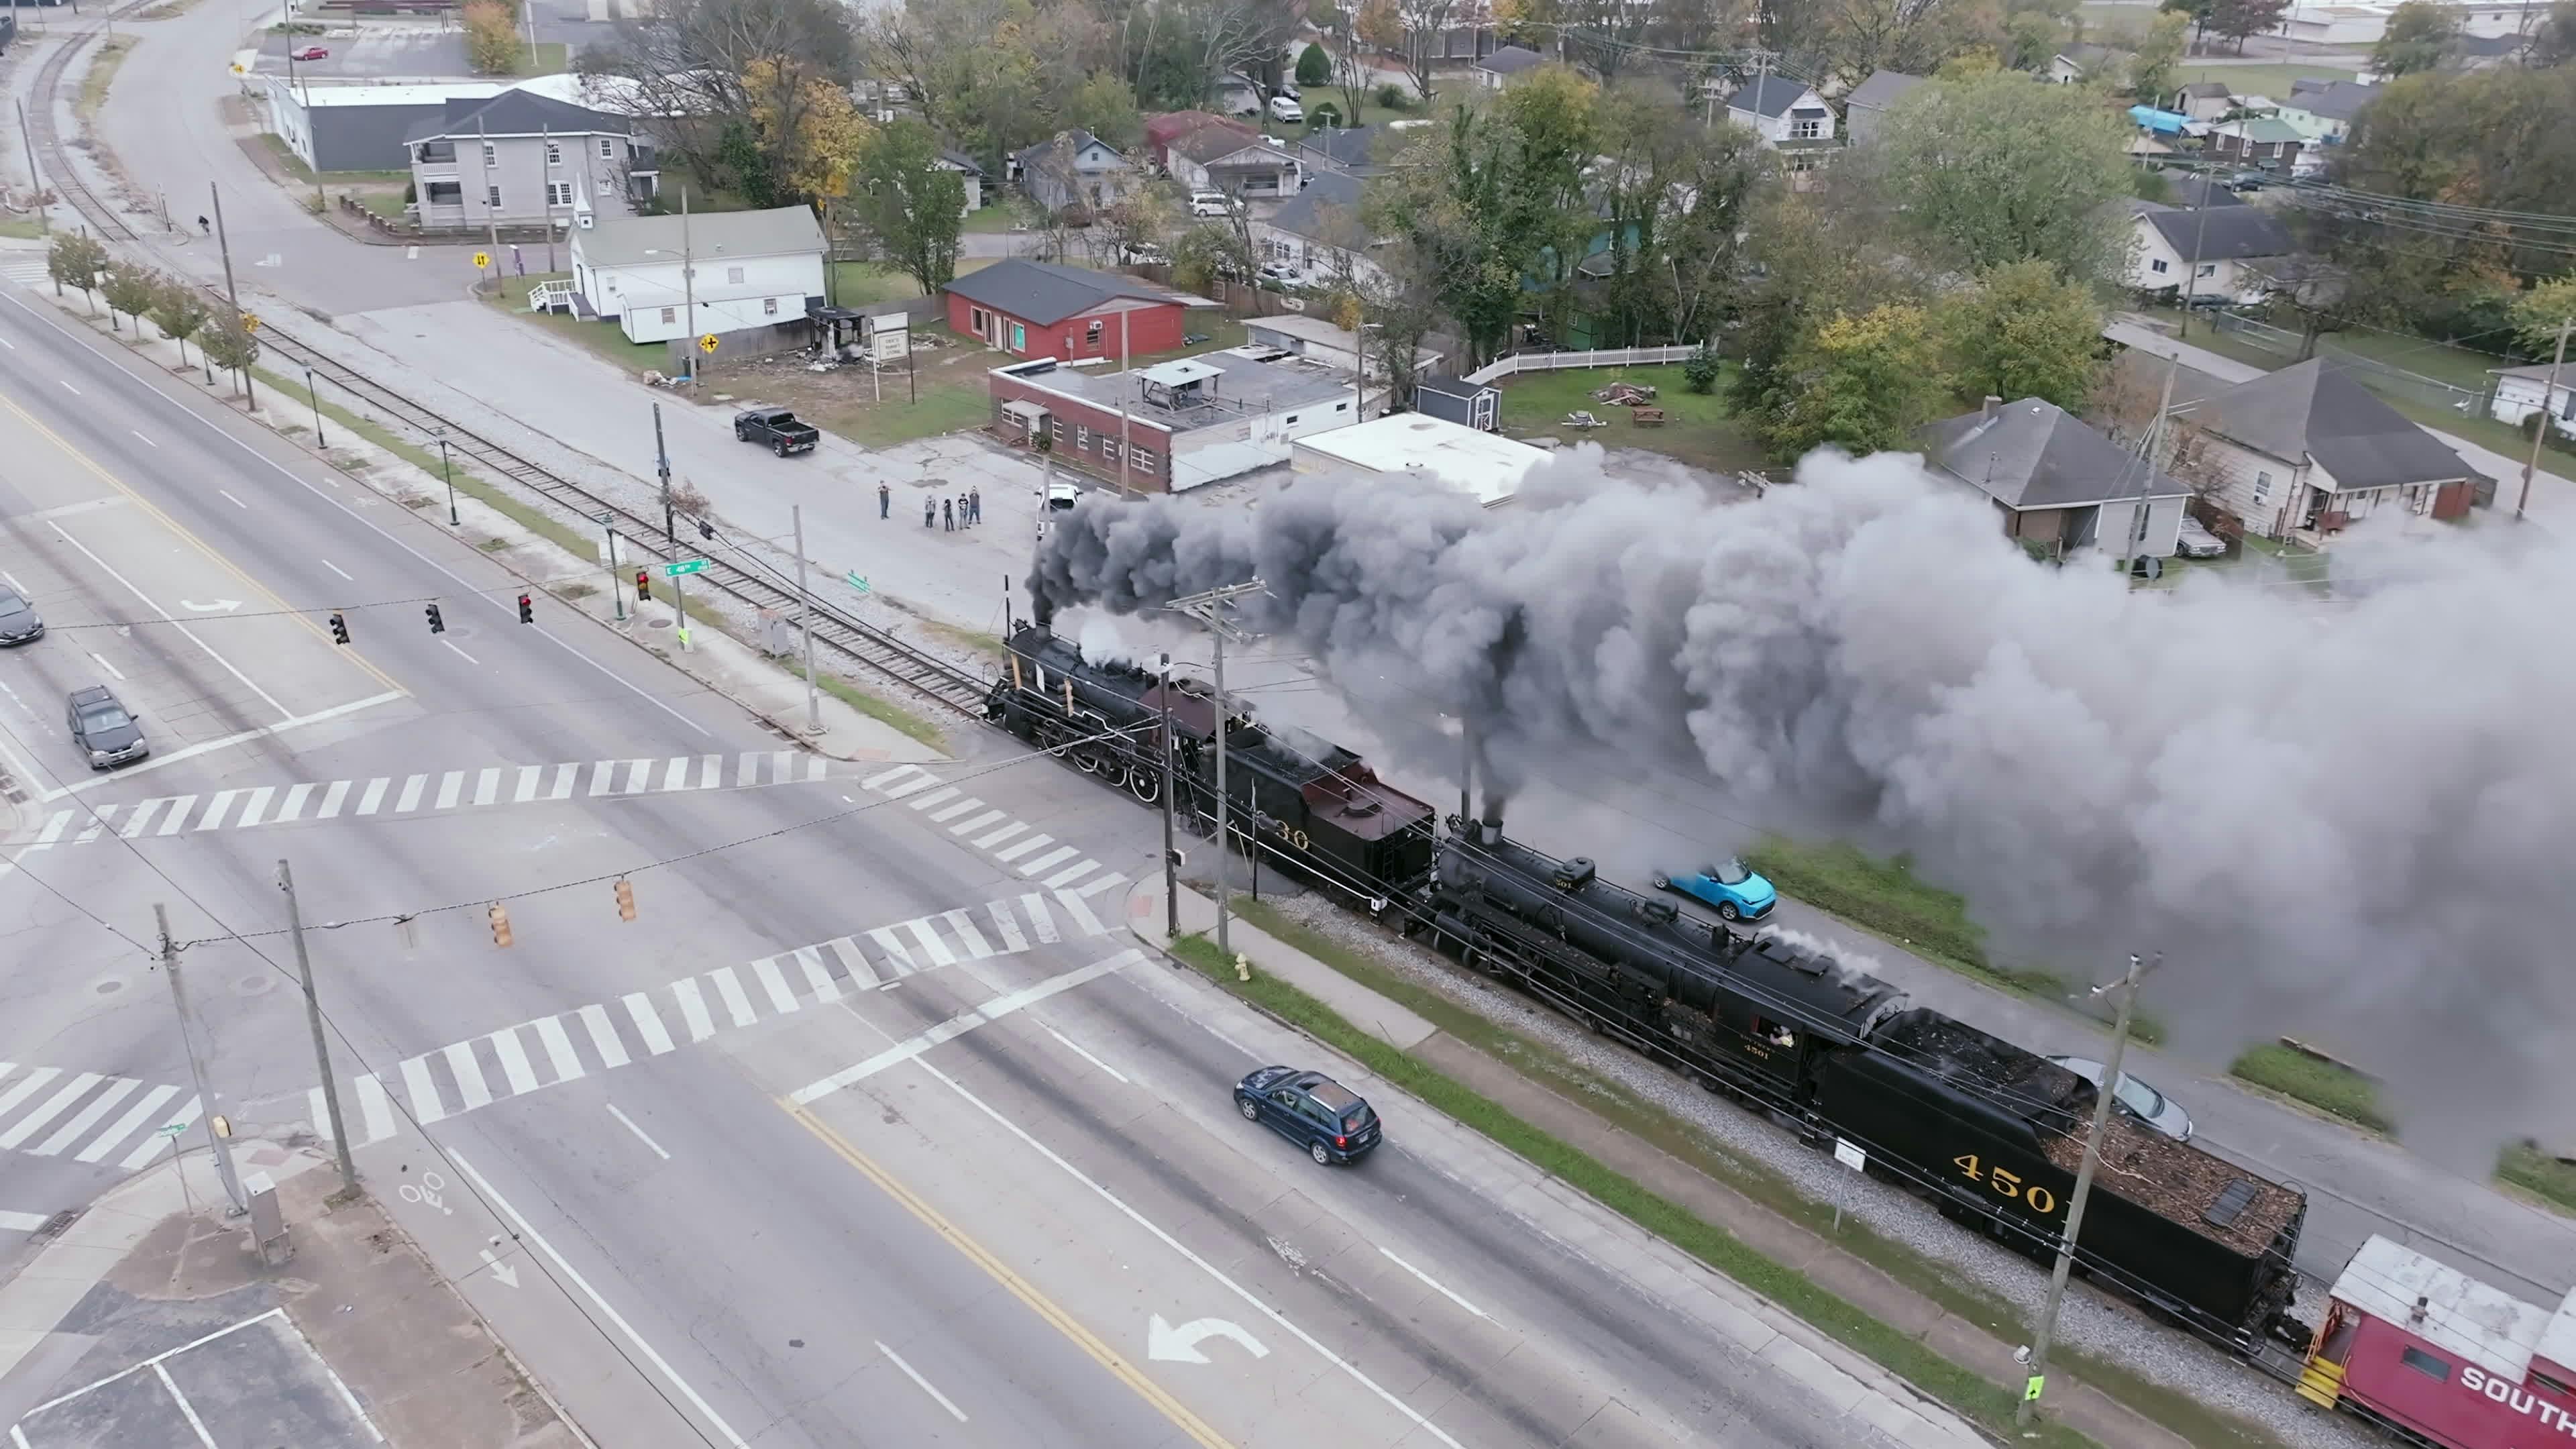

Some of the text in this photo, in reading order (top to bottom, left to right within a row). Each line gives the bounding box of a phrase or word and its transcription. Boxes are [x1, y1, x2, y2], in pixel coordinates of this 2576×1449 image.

[666, 567, 672, 575] E
[1744, 1044, 1769, 1060] 4501
[1953, 1154, 2070, 1224] 450
[2460, 1366, 2576, 1439] SOUTH
